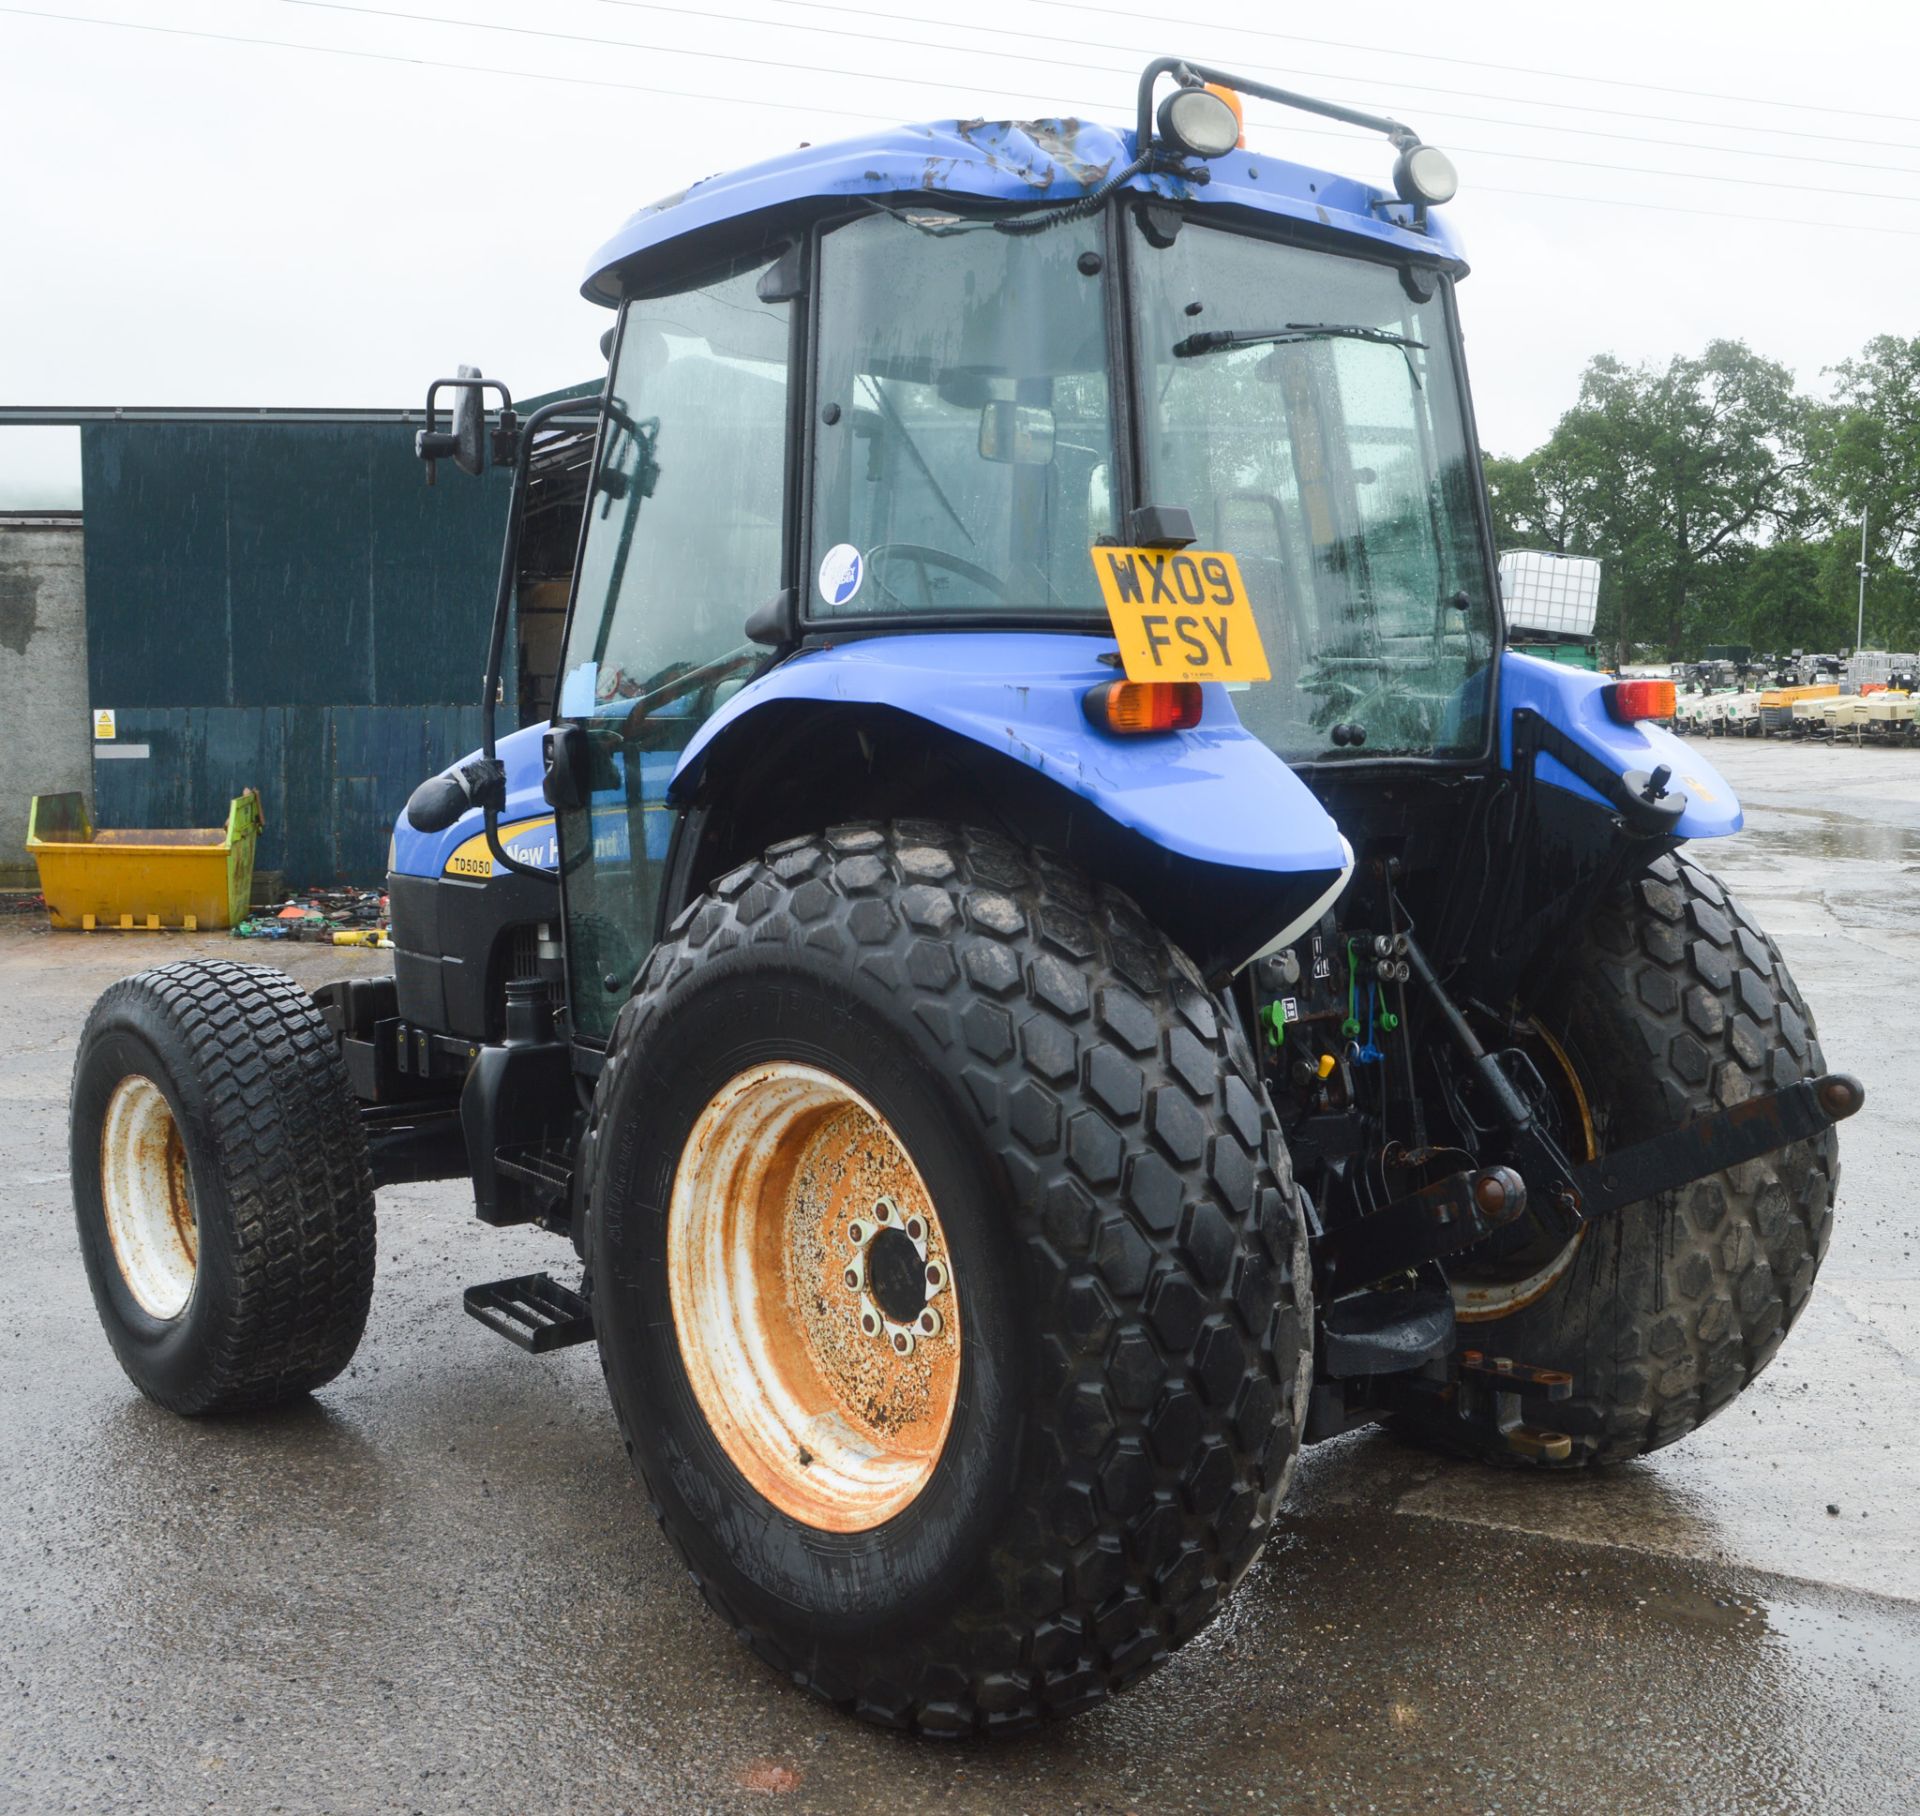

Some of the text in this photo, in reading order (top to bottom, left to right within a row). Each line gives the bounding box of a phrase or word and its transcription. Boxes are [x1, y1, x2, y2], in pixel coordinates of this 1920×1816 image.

[1106, 553, 1235, 606] WX09
[1141, 615, 1233, 666] FSY
[454, 857, 491, 874] TD5050
[505, 843, 544, 866] New
